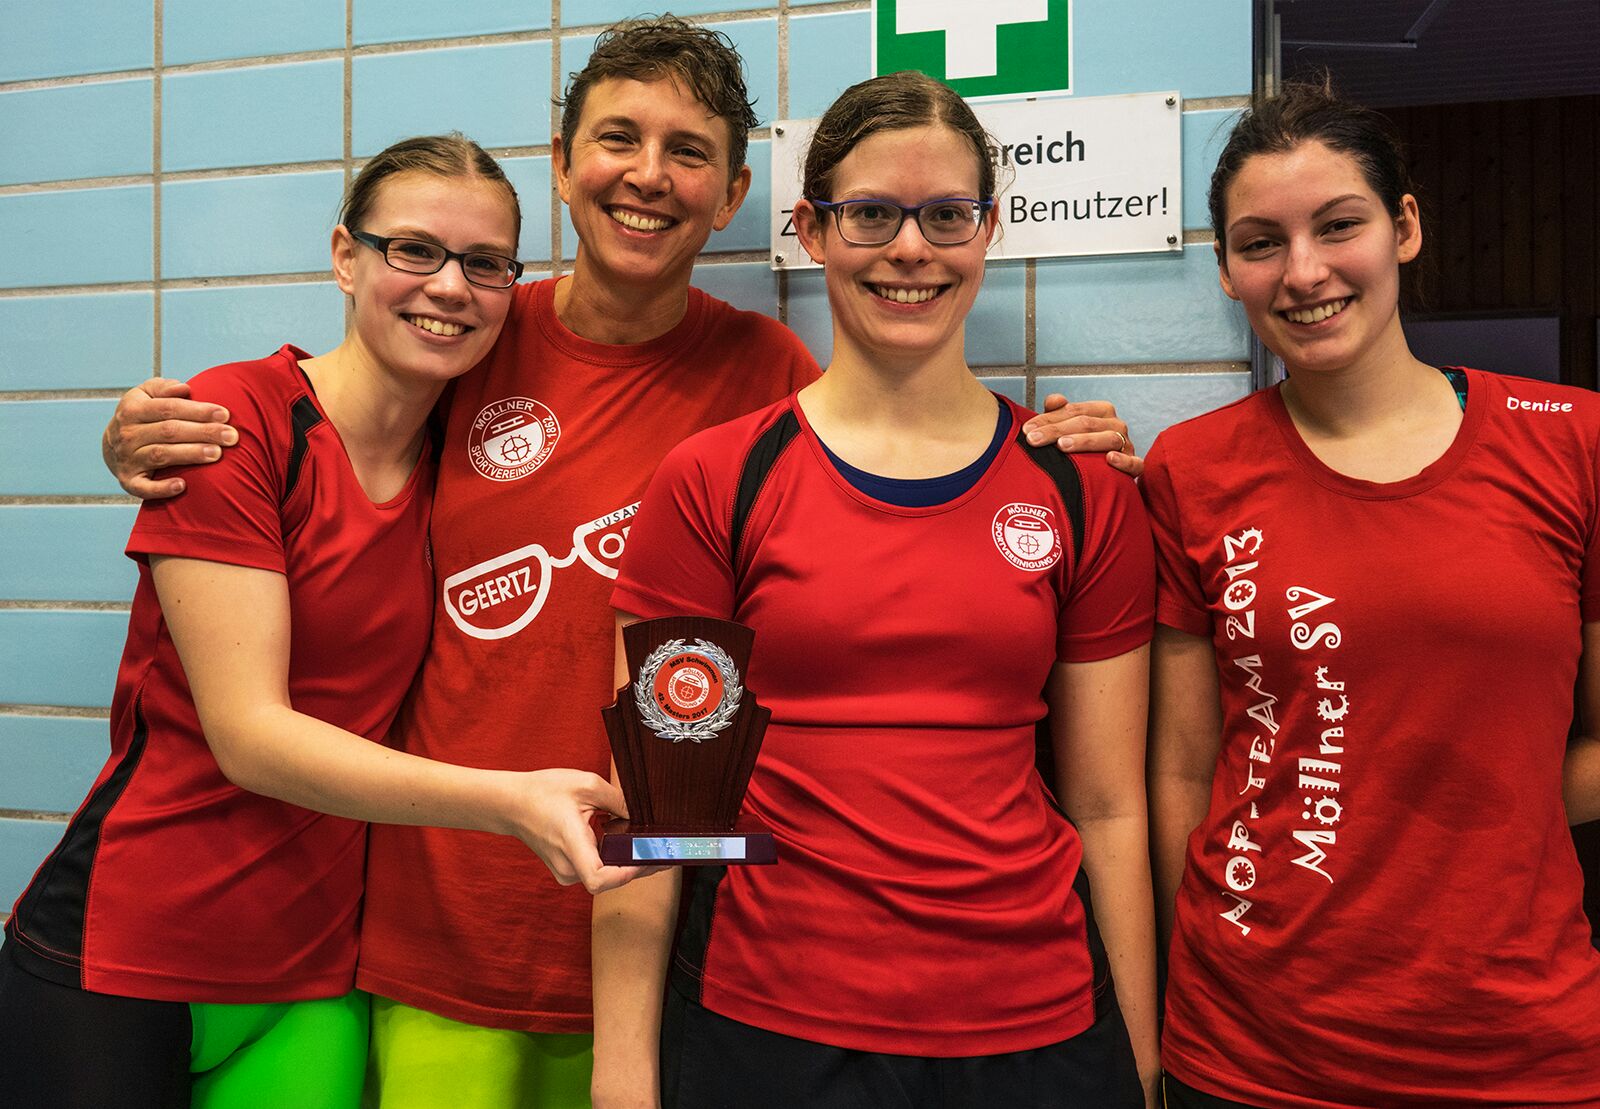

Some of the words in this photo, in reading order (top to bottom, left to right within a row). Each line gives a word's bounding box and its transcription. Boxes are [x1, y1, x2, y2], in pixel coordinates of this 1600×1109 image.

[1009, 187, 1168, 224] Benutzer!
[475, 400, 535, 431] MÖLLNER
[1506, 396, 1573, 412] Denise
[471, 444, 551, 479] SPORTVEREINIGUNG
[542, 415, 558, 438] 1862
[995, 521, 1053, 568] SPORTVEREINIGUNG
[458, 566, 537, 616] GEERTZ
[1223, 527, 1264, 641] 2013
[1285, 585, 1342, 650] SV
[669, 657, 685, 668] MSV
[686, 656, 719, 683] Schwimmen
[663, 704, 691, 719] Masters
[691, 707, 708, 719] 2017
[1290, 665, 1350, 884] Möllner
